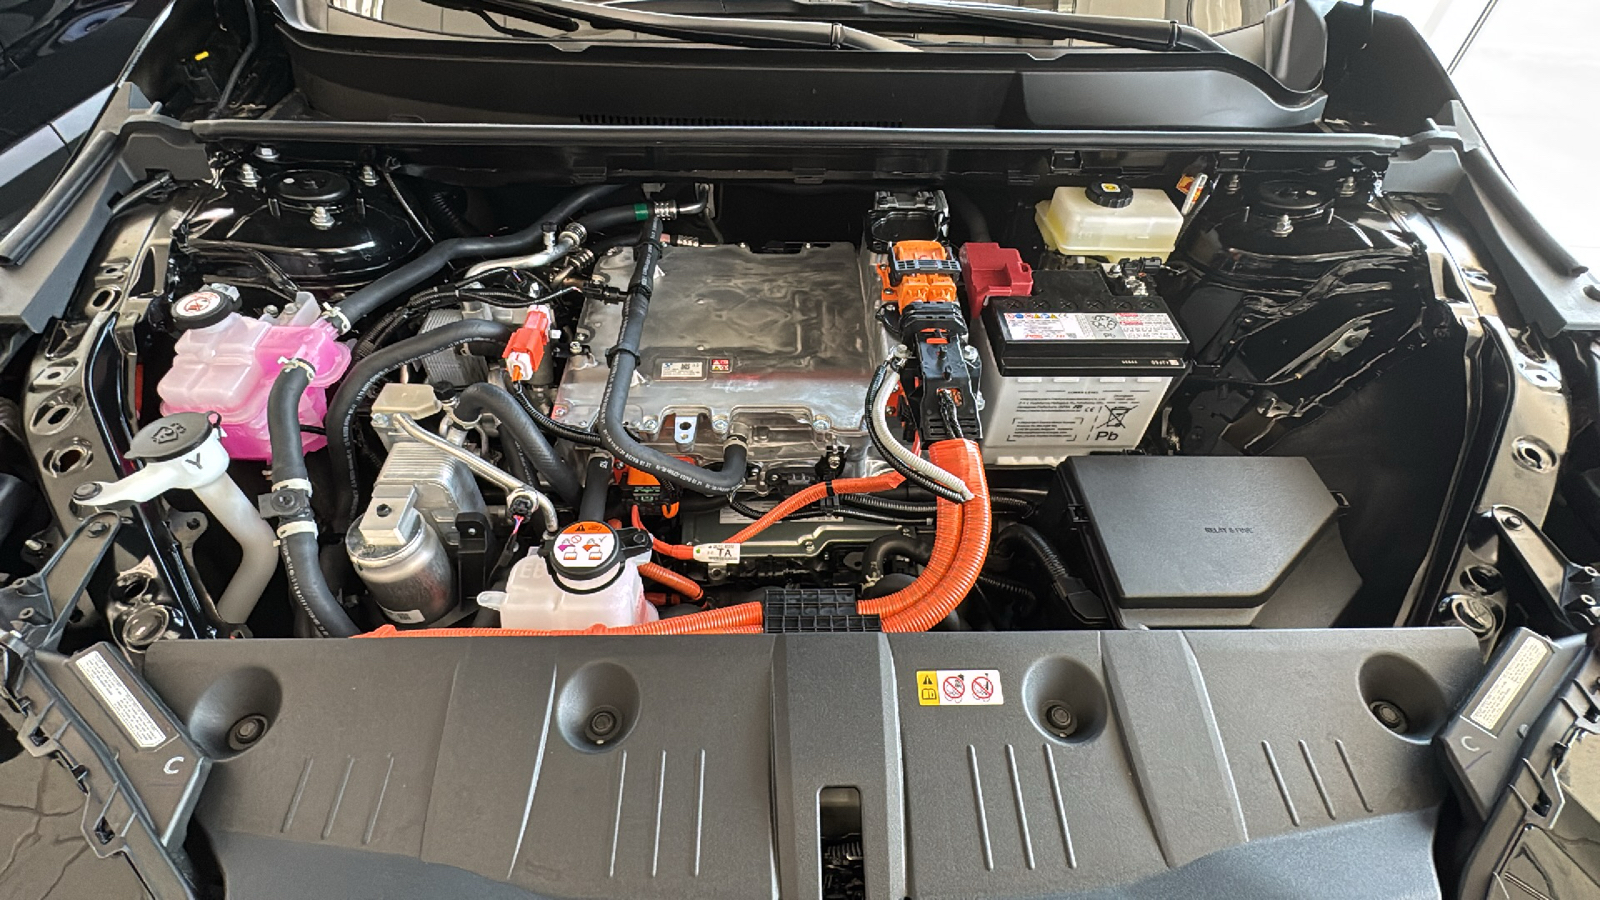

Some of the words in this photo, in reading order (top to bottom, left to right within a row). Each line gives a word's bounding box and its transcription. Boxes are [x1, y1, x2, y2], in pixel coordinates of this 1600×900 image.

[1095, 430, 1119, 441] Pb
[716, 547, 732, 557] TA
[163, 756, 184, 774] C
